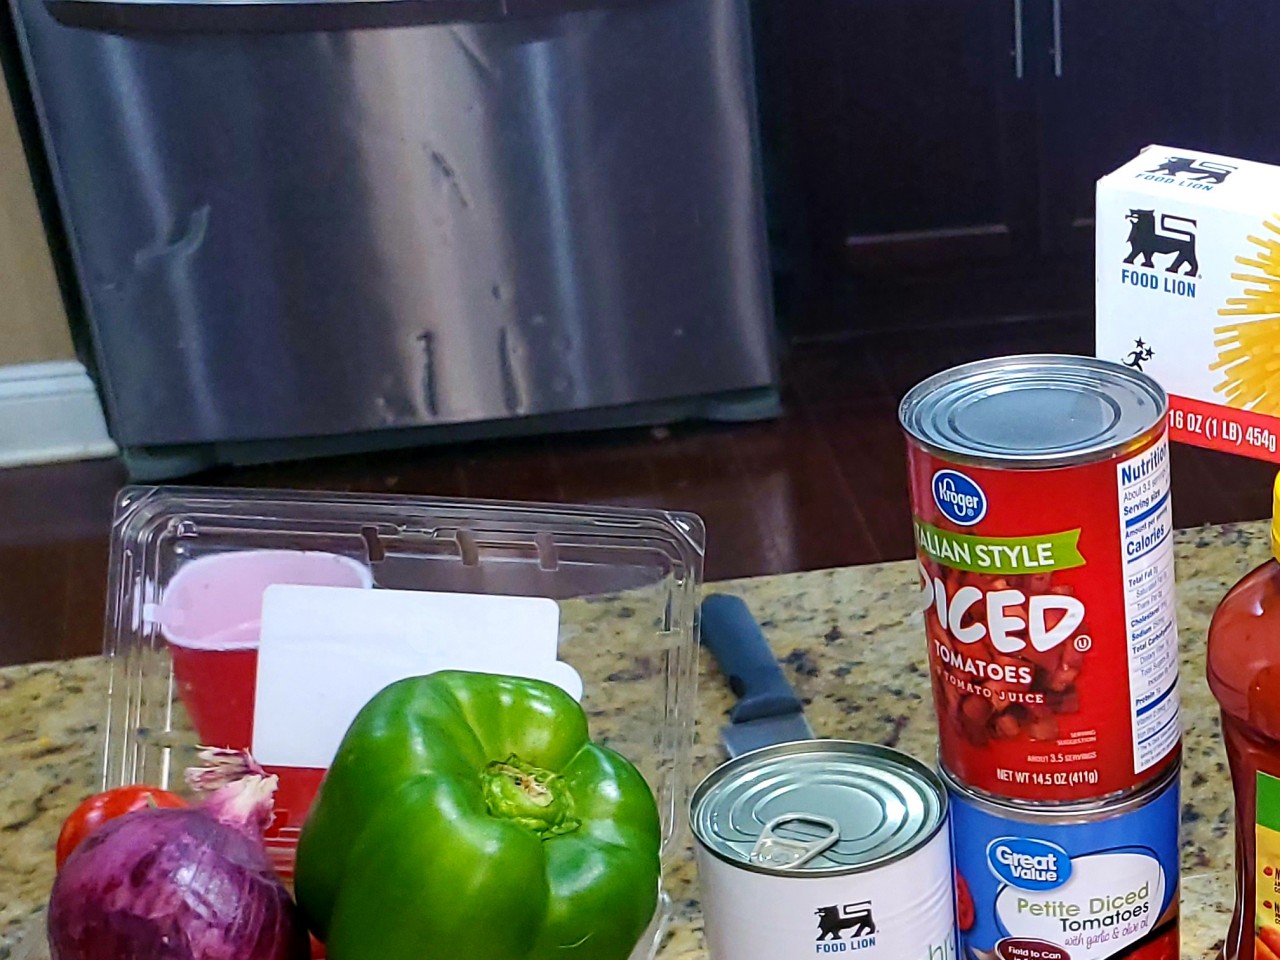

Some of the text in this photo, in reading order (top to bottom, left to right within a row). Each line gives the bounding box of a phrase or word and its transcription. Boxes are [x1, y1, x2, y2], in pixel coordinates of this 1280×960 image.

[1134, 173, 1215, 192] FOOD LION
[1121, 268, 1197, 299] FOOD LION
[1168, 409, 1277, 453] 16 OZ (1 LB) 454g
[938, 476, 980, 517] Kroger
[1126, 523, 1165, 556] Calories
[977, 542, 1055, 568] STYLE
[933, 638, 1033, 685] TOMATOES
[944, 672, 1045, 704] TOMATO JUICE
[1050, 753, 1064, 763] 3.5
[997, 767, 1099, 787] NET WT 14.5 OZ (411g)
[995, 845, 1058, 871] Great
[1009, 864, 1058, 883] Value
[1017, 880, 1150, 918] Petite Diced
[1060, 900, 1150, 933] Tomatoes
[815, 936, 877, 954] FOOD LION
[1008, 945, 1062, 960] Field Can
[1064, 929, 1111, 950] with garlic
